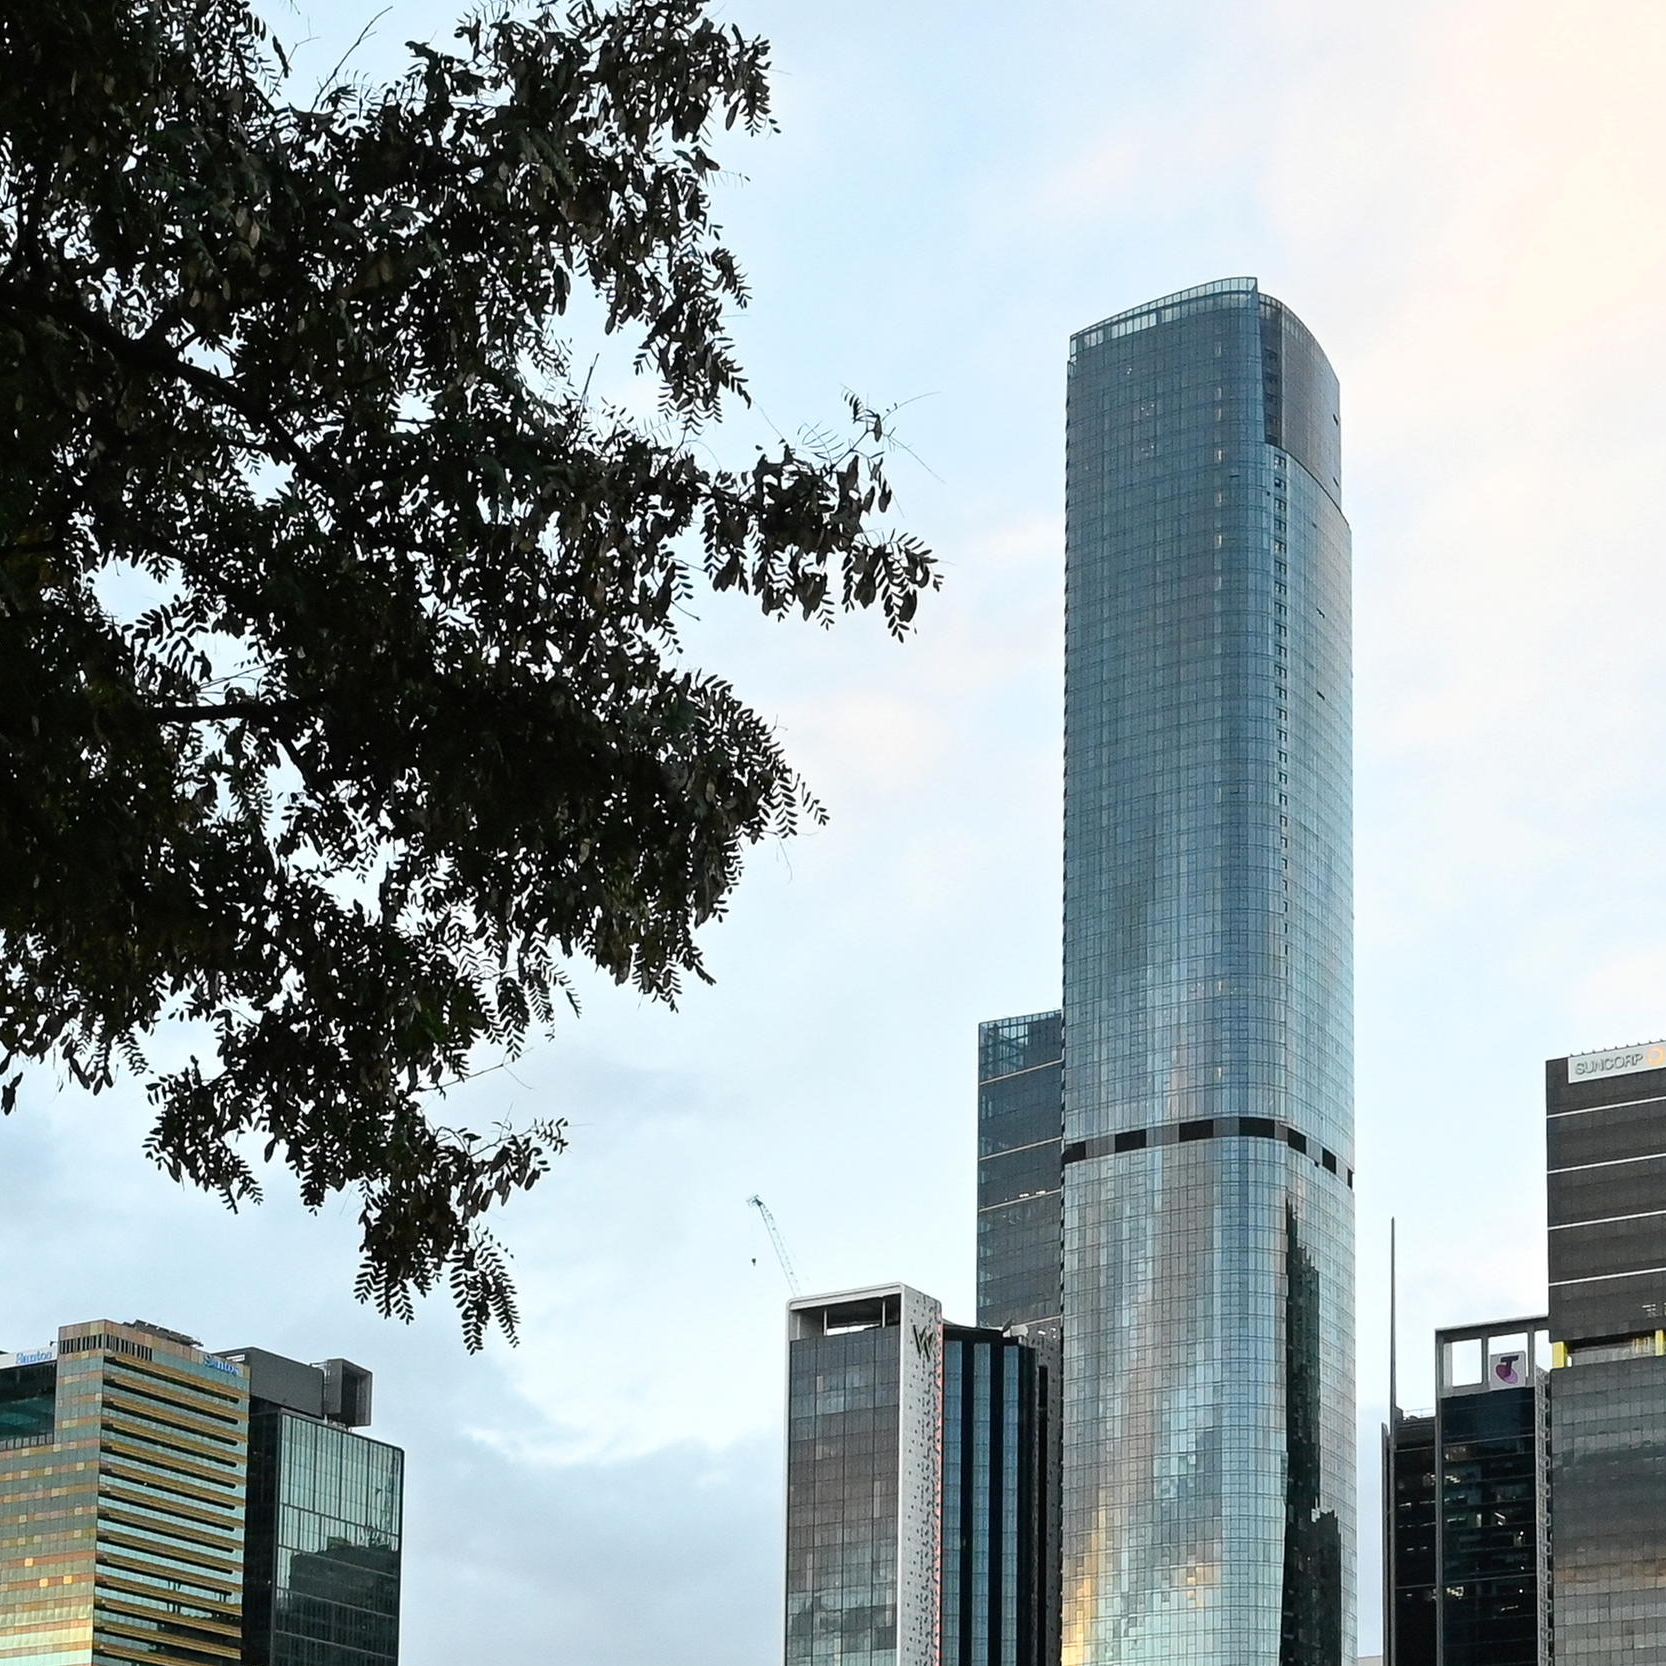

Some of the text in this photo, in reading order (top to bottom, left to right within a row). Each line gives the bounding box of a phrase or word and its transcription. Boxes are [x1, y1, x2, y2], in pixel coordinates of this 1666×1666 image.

[1575, 1053, 1644, 1075] SUNCORP
[16, 1350, 55, 1364] Santos
[204, 1354, 239, 1376] Santos
